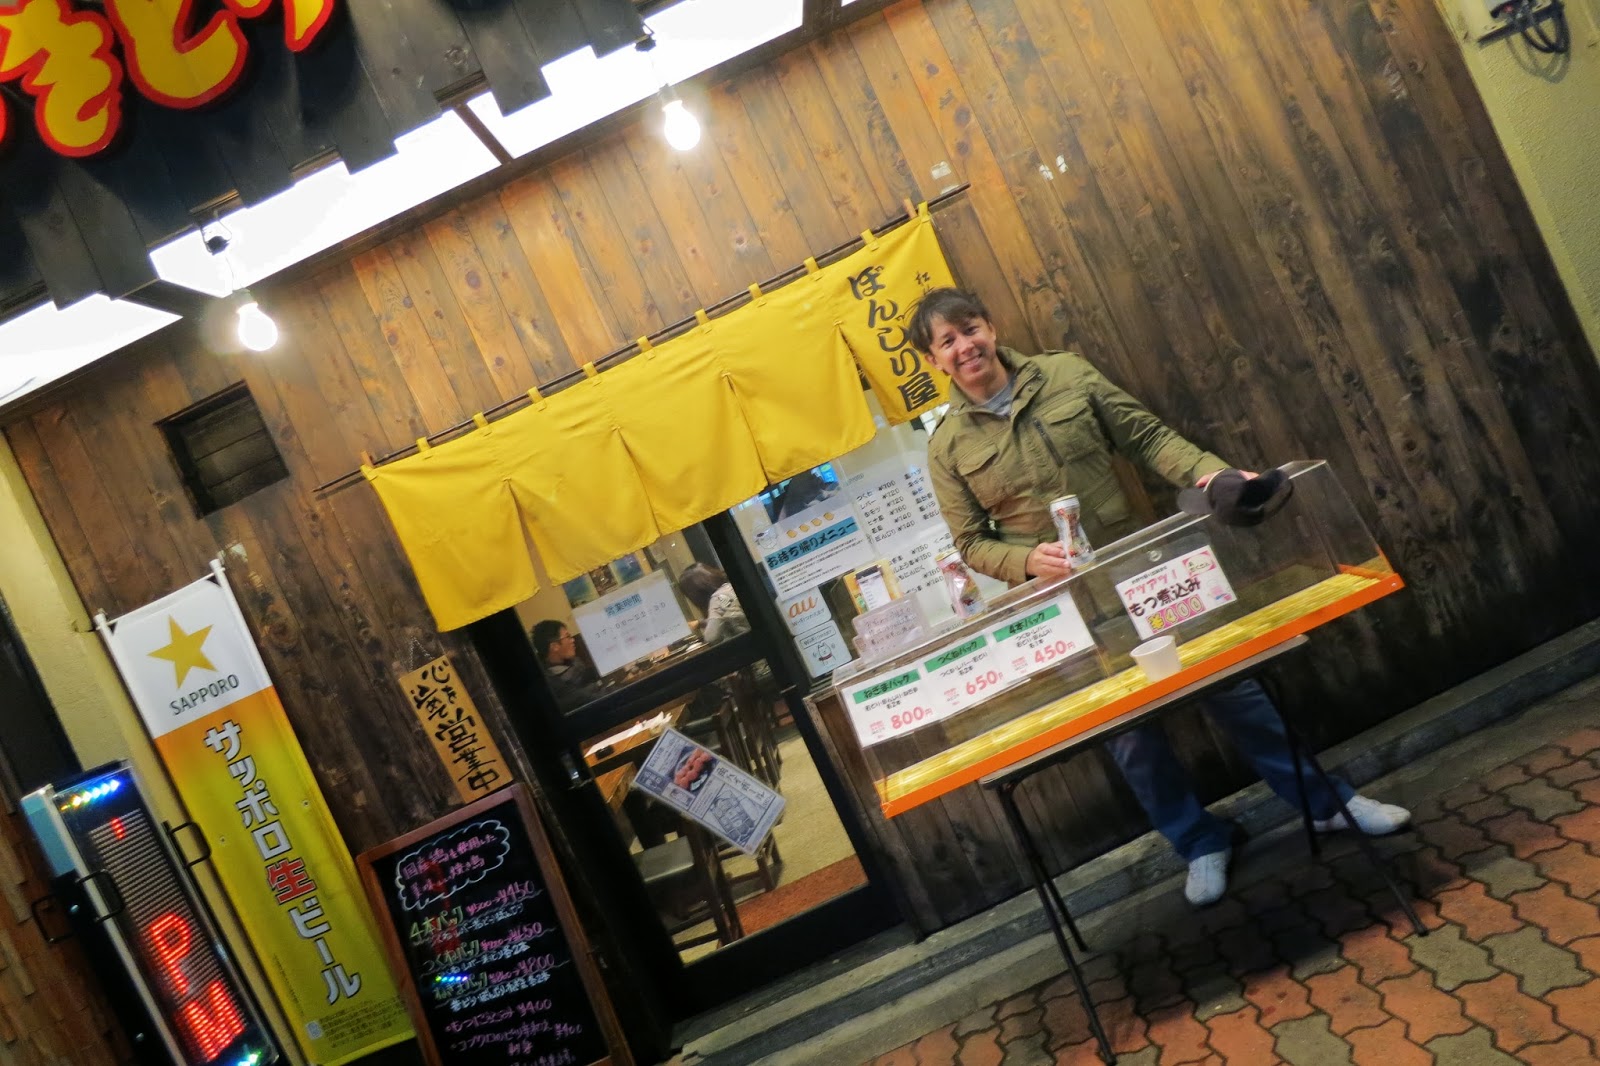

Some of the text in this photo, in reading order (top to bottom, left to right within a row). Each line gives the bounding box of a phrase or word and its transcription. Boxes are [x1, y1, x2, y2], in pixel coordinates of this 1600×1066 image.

[848, 265, 940, 412] ぼんじり屋
[767, 520, 857, 567] お待ち帰りメニュー
[604, 593, 642, 617] 営業時間
[788, 595, 820, 619] au
[1128, 577, 1202, 617] もつ煮込み
[1008, 612, 1046, 636] 4本パック
[1147, 593, 1205, 632] ¥400
[936, 640, 978, 665] つくねパック
[1033, 639, 1076, 664] 450円
[169, 673, 240, 717] SAPPORO
[863, 673, 911, 699] ねぎまパック
[890, 705, 933, 730] 800円
[203, 719, 363, 1006] サッポロ生ビール
[410, 906, 464, 938] 4本パック
[423, 940, 480, 970] つくねパック
